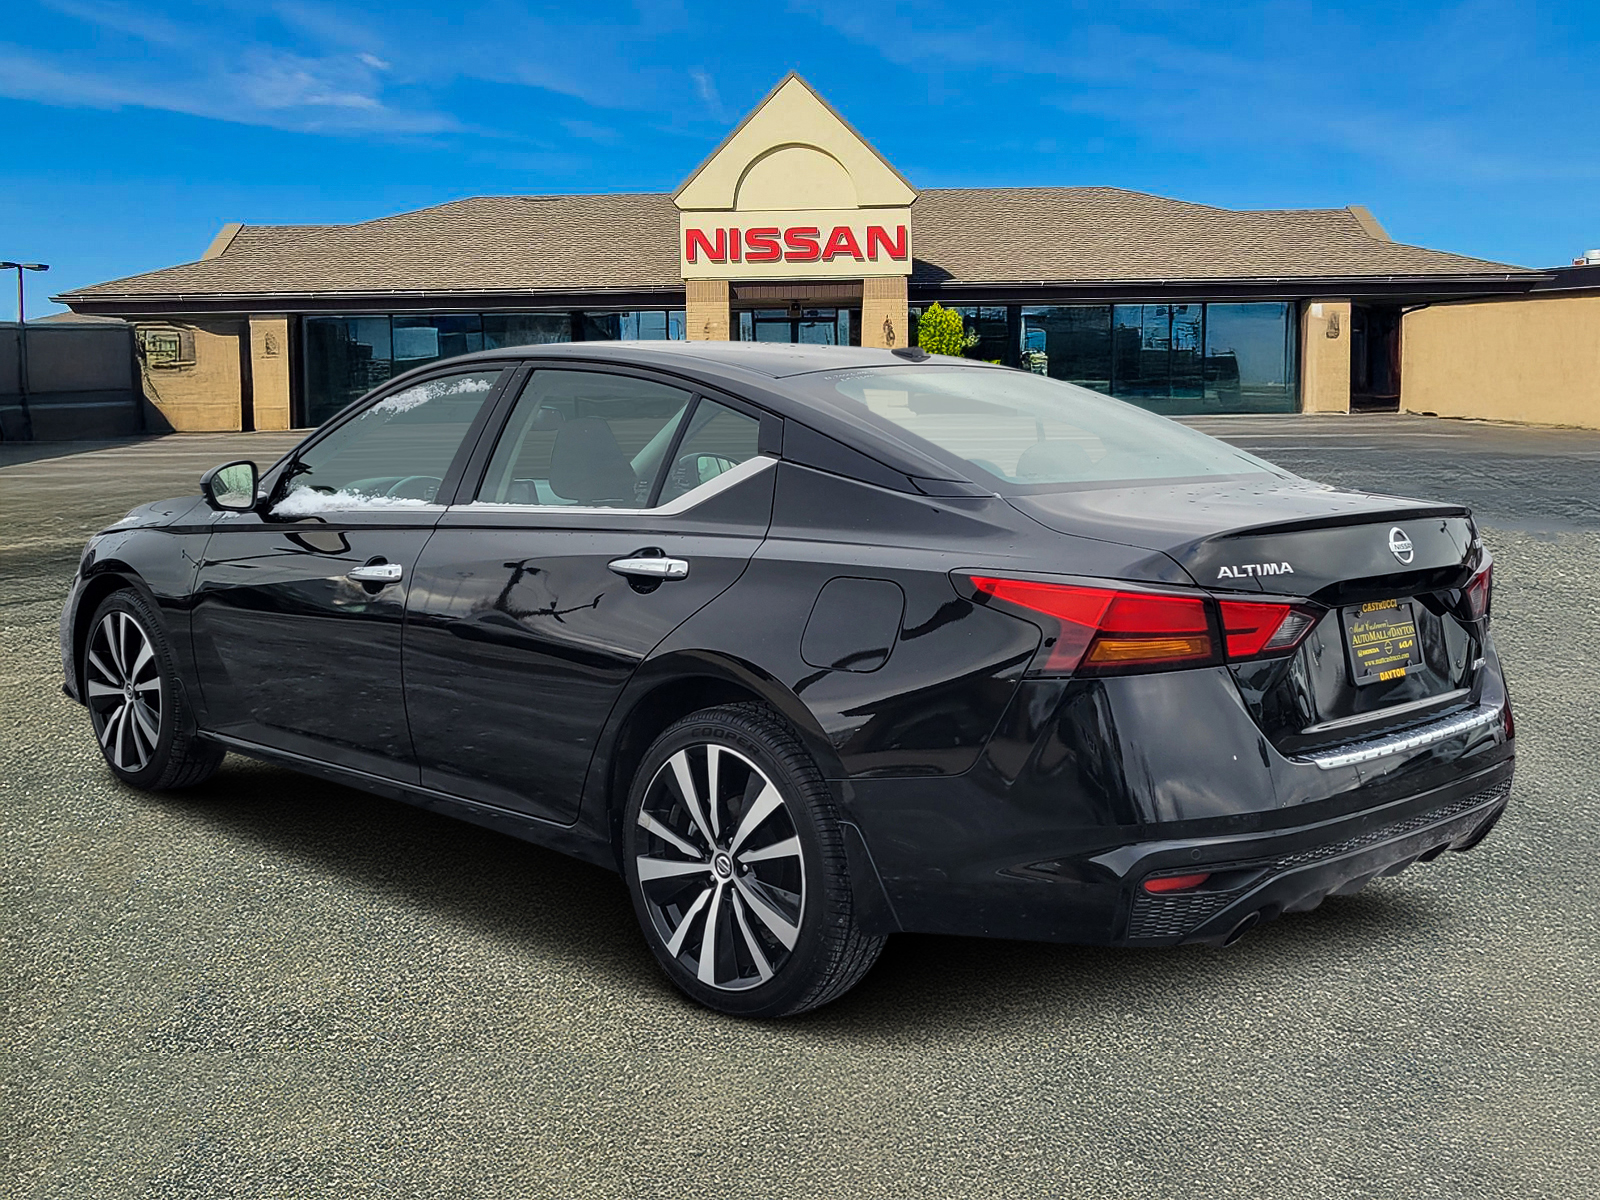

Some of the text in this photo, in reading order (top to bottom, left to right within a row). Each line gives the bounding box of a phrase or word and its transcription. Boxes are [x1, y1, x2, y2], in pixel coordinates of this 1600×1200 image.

[685, 225, 908, 264] NISSAN
[1216, 561, 1294, 579] ALTIMA
[1362, 599, 1397, 613] CASTRUCCI
[1379, 668, 1406, 681] DAYTON
[691, 727, 760, 756] COOPER
